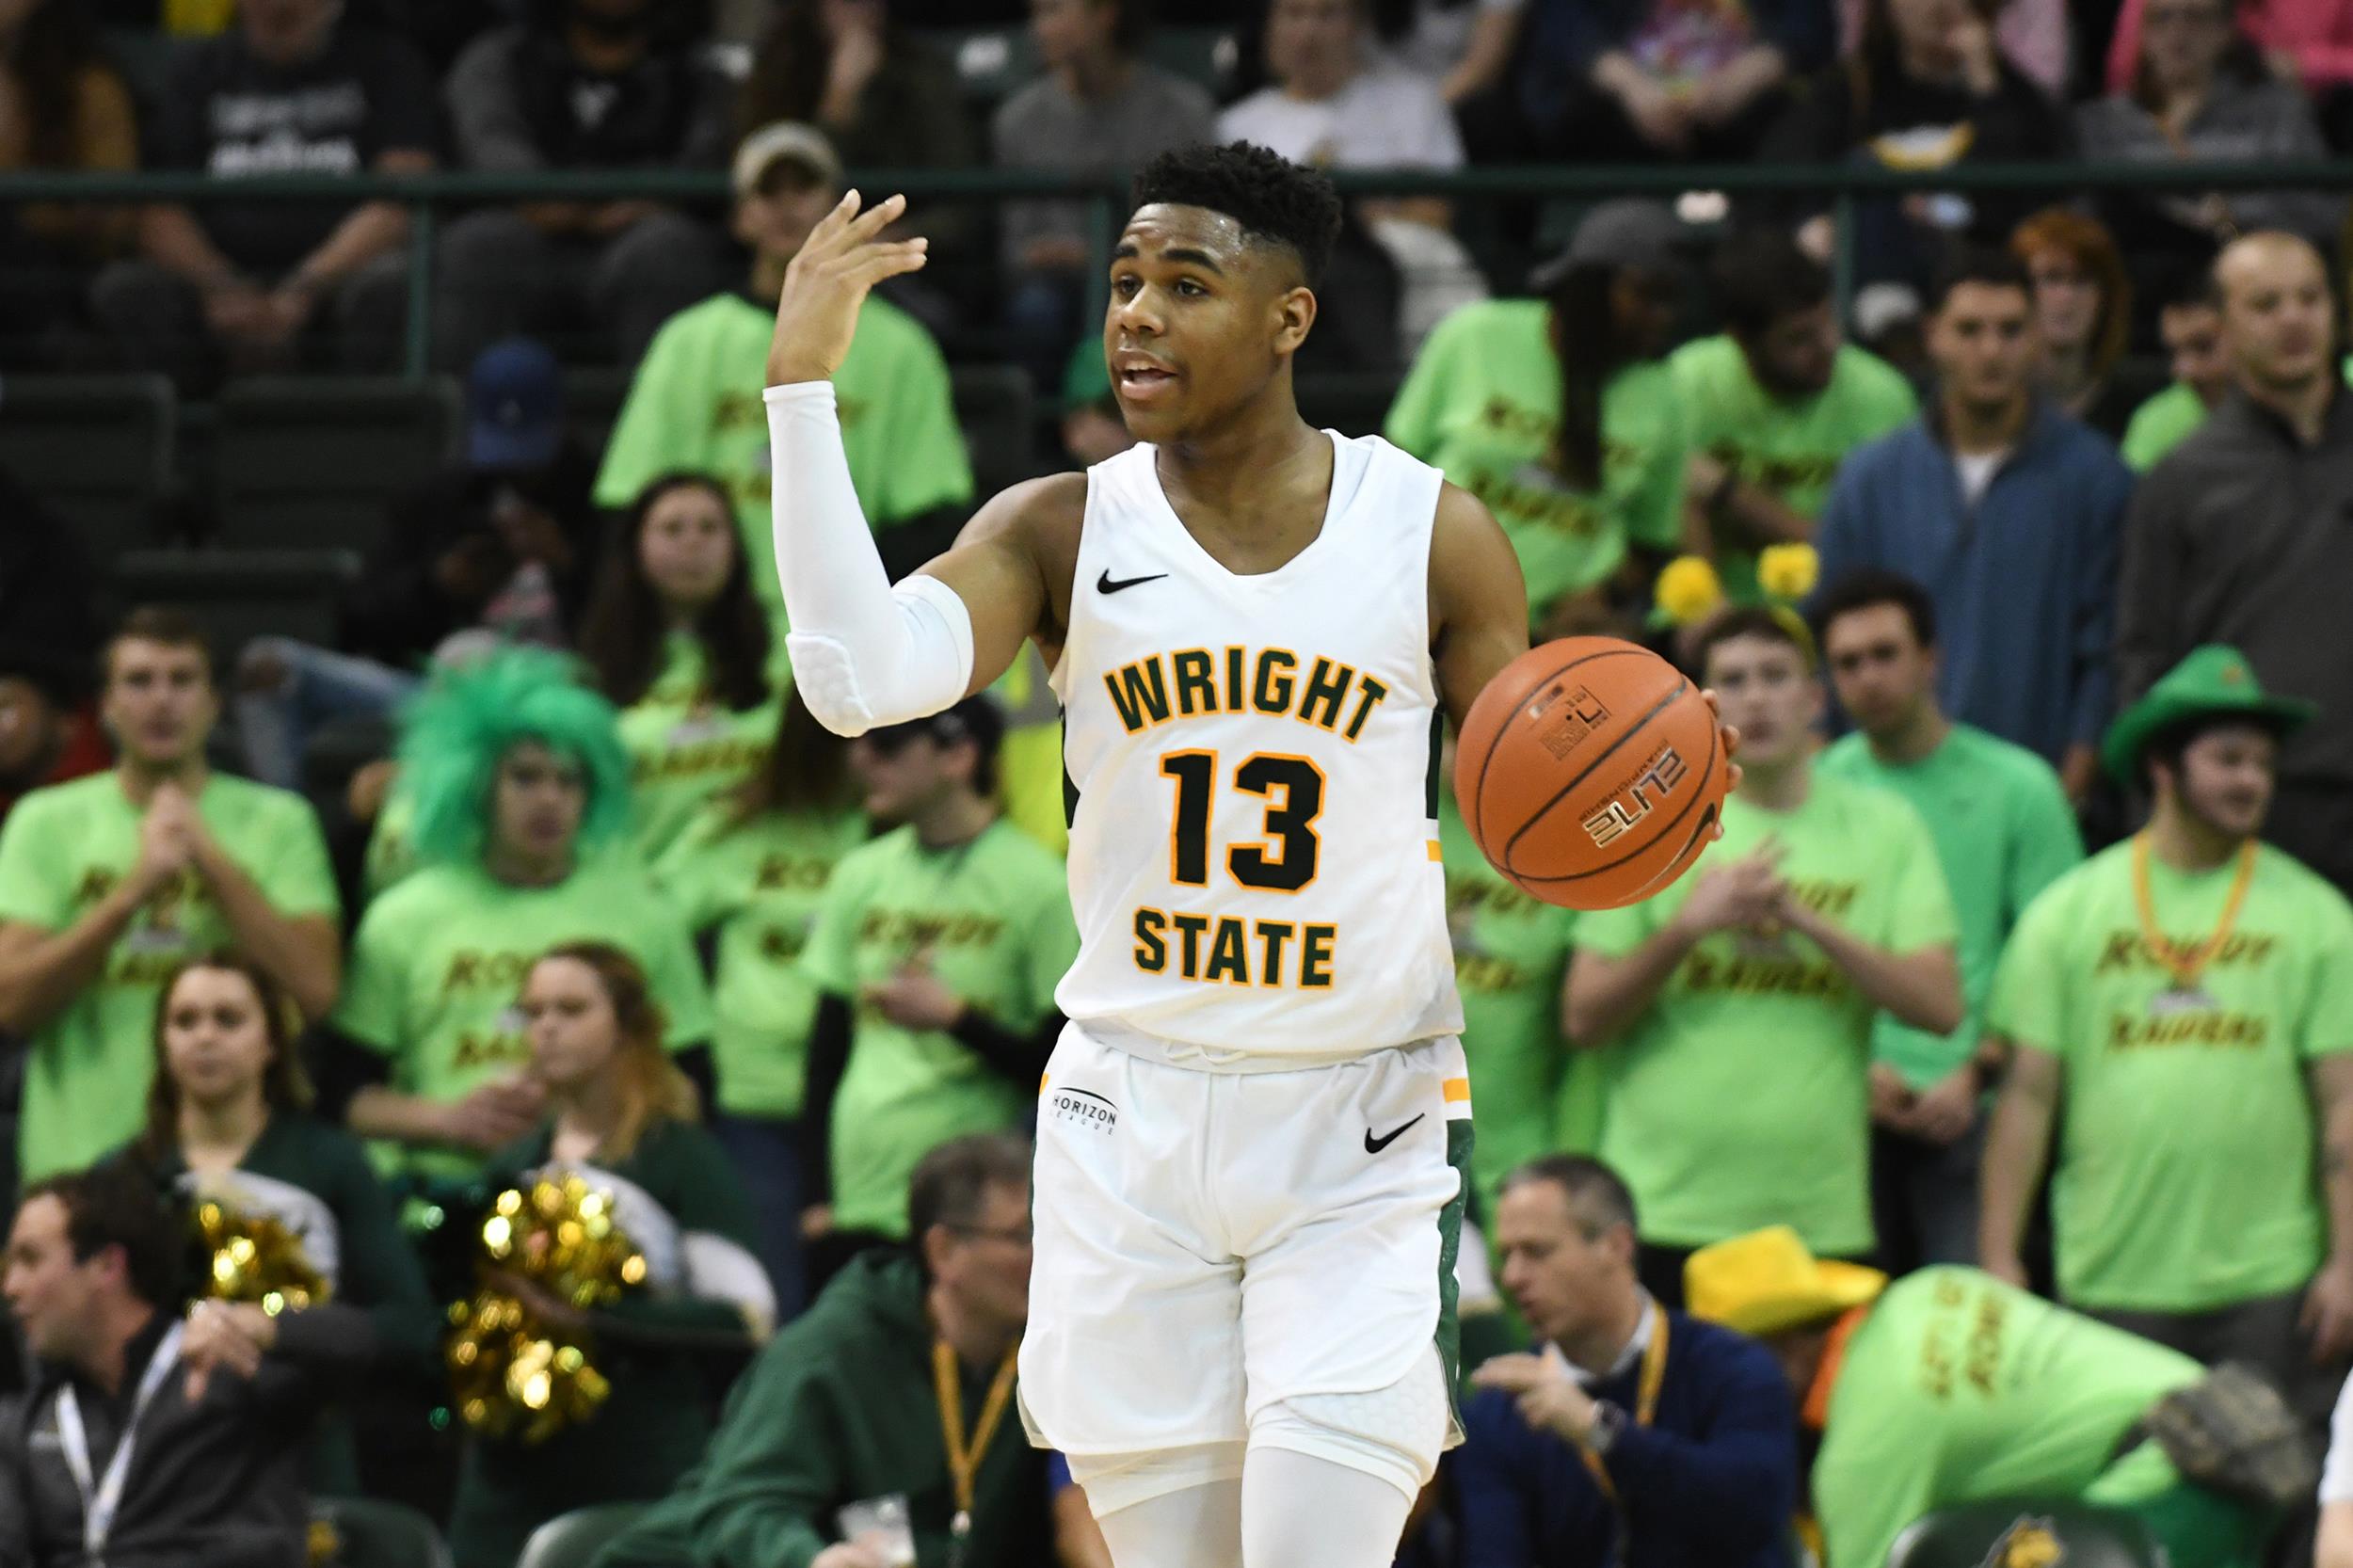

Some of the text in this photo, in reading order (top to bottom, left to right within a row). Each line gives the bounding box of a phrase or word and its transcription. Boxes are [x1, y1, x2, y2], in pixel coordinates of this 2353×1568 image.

[1103, 645, 1392, 744] WRIGHT
[1159, 747, 1327, 896] 13
[1582, 746, 1688, 848] ELITE
[1132, 904, 1338, 990] STATE
[1053, 1096, 1116, 1125] HORIZON
